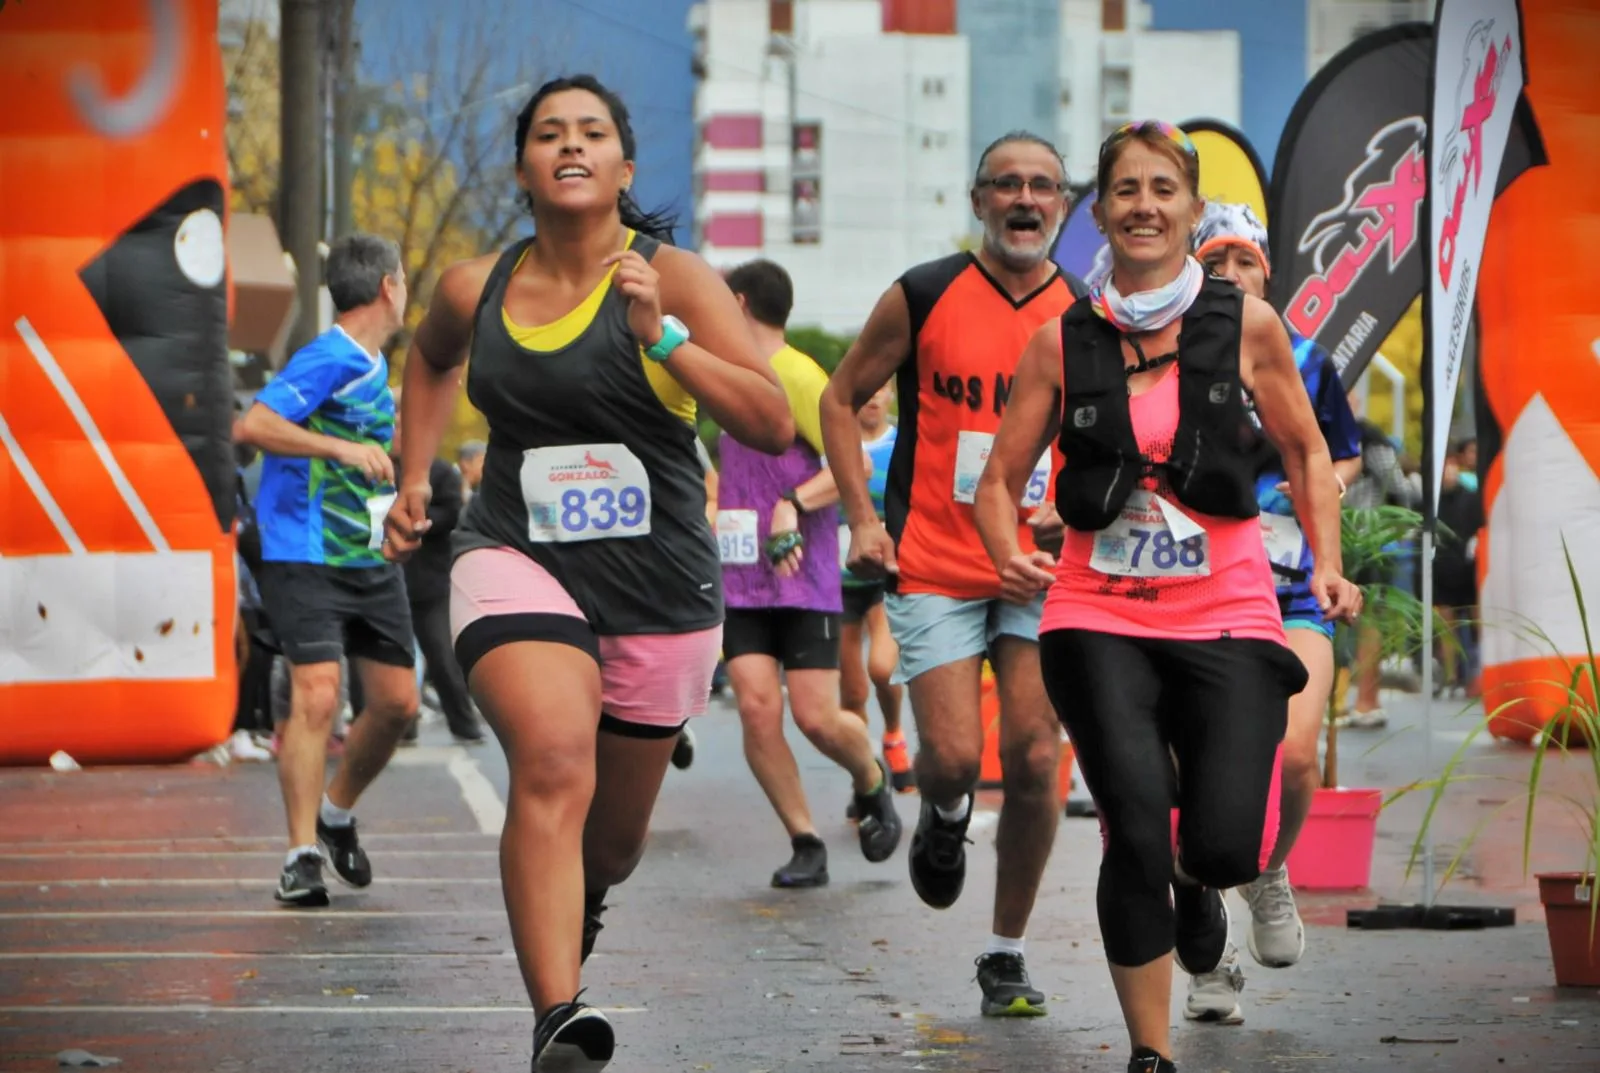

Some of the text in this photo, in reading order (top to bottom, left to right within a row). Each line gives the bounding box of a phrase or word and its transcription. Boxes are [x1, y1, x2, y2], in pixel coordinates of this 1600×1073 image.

[933, 371, 983, 412] LOS
[548, 470, 610, 482] GONZALO
[560, 485, 646, 532] 839
[721, 533, 755, 558] 915
[1129, 529, 1205, 569] 788
